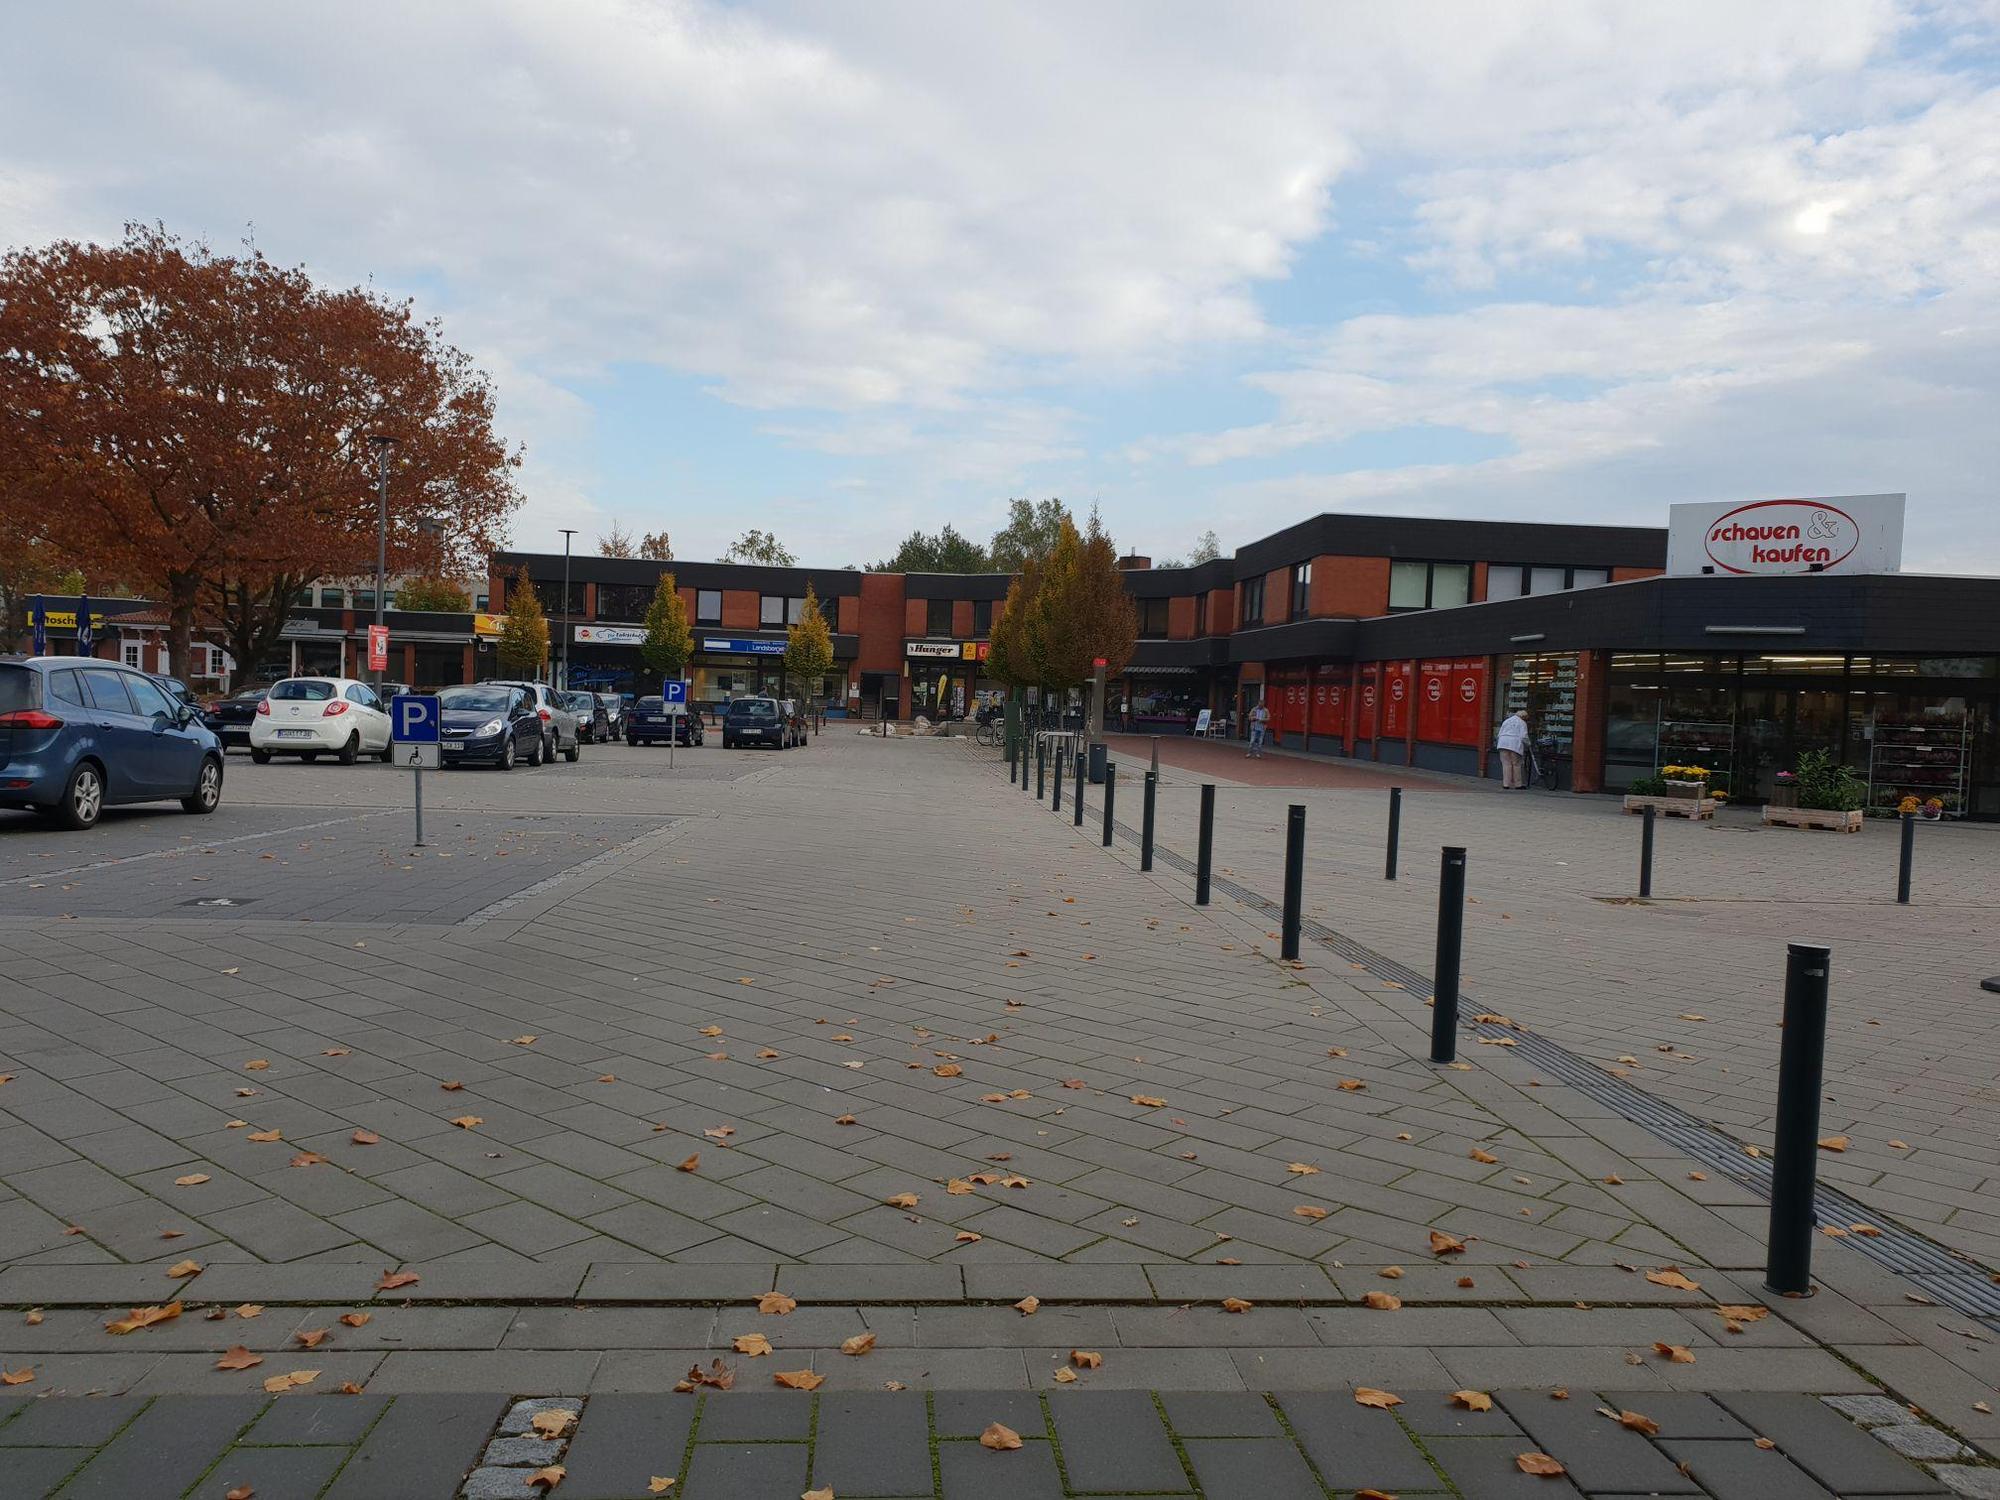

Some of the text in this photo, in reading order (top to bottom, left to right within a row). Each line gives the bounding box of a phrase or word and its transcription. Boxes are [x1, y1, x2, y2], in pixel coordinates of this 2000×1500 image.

[1711, 510, 1838, 542] schauen &
[1752, 543, 1830, 563] kaufen
[668, 684, 681, 700] P
[403, 702, 428, 736] P
